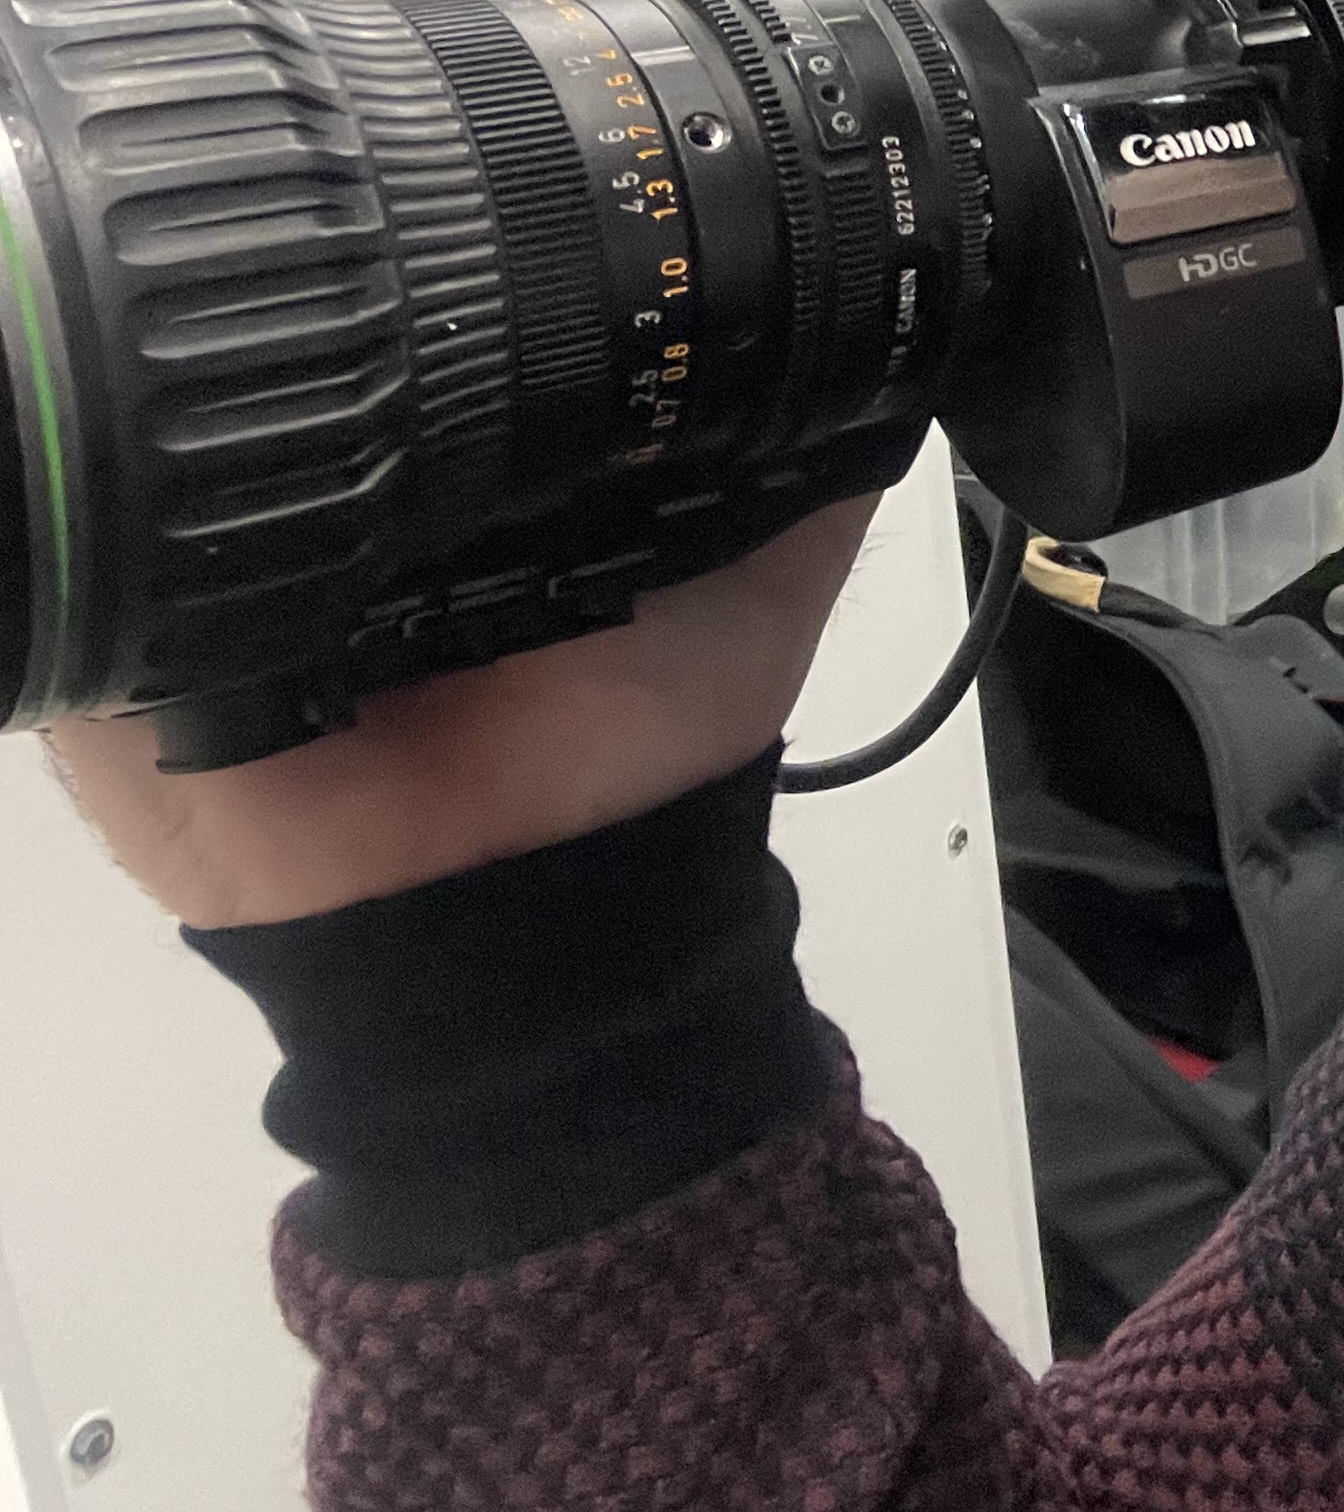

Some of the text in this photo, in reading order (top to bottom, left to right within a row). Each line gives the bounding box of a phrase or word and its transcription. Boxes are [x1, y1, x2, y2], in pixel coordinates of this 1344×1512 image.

[598, 129, 626, 143] 6
[627, 124, 664, 160] 1.7
[1119, 120, 1256, 166] Canon
[612, 172, 646, 213] 4.5
[646, 179, 678, 220] 1.3
[661, 257, 688, 297] 1.0
[635, 310, 661, 328] 3
[662, 343, 690, 382] 0.8
